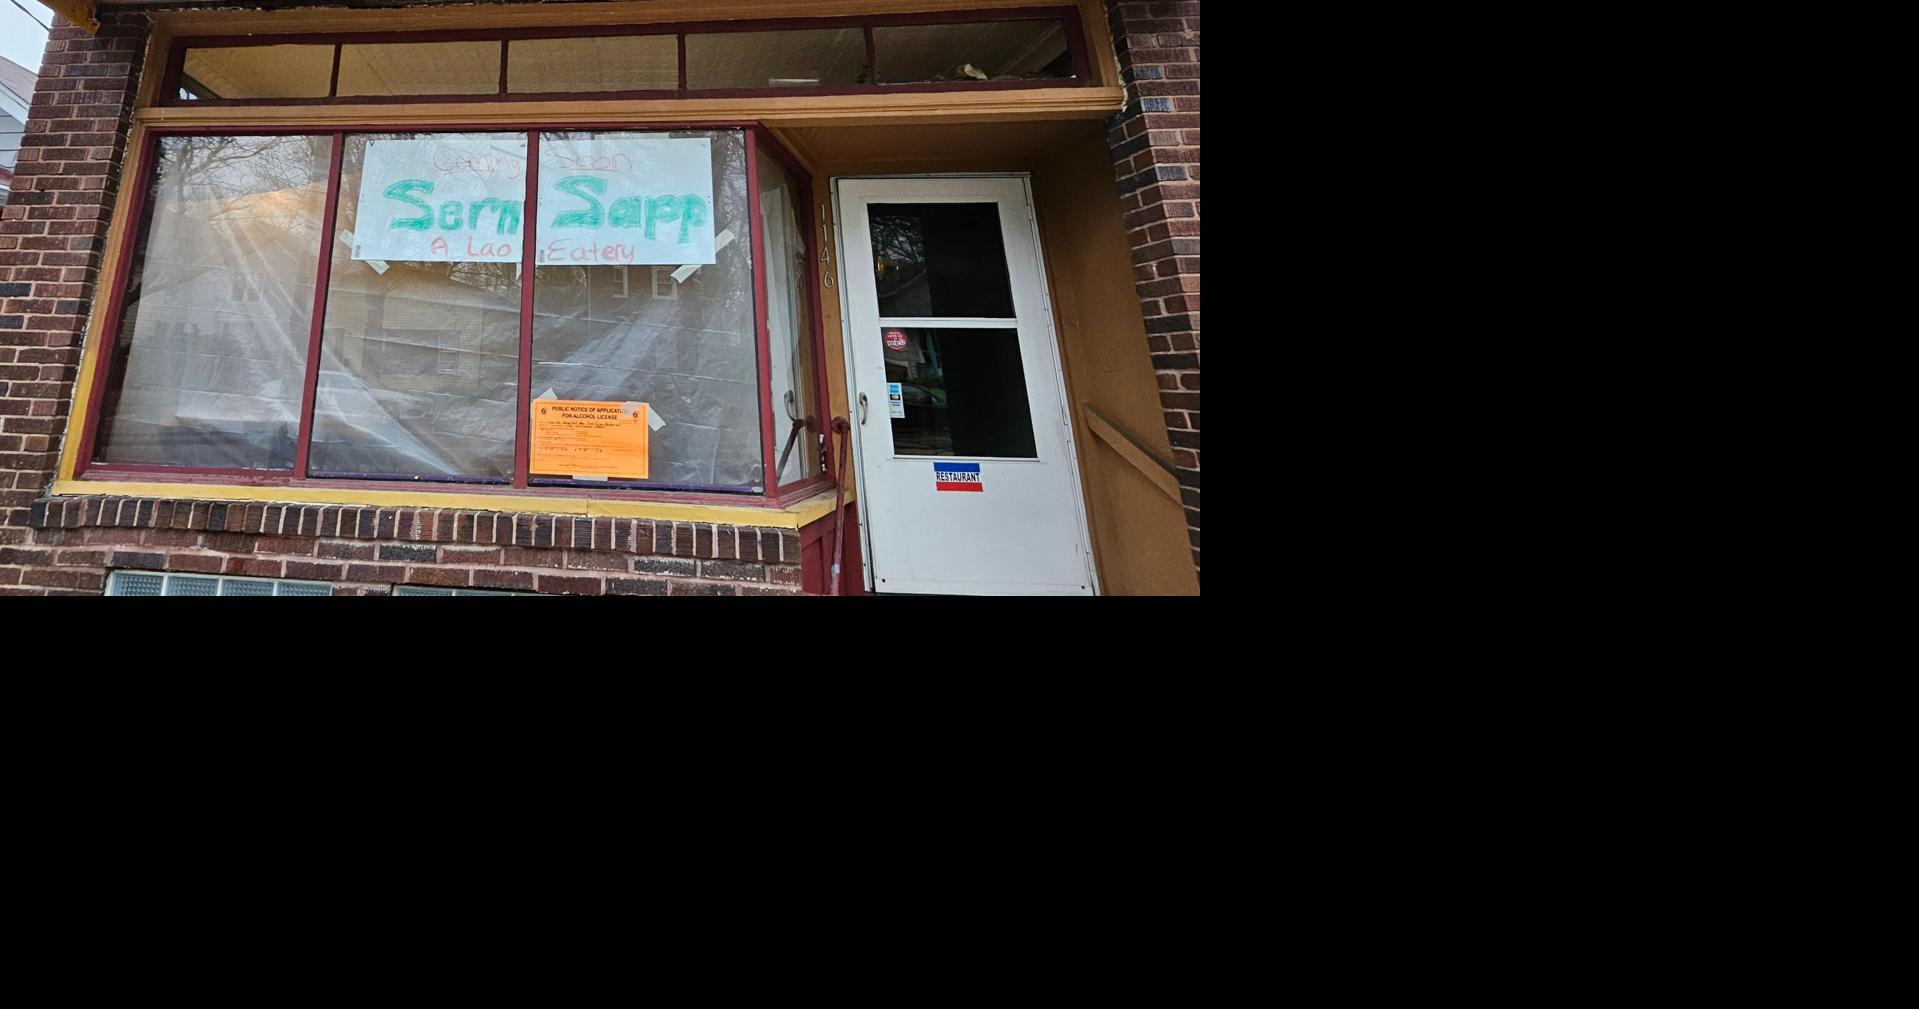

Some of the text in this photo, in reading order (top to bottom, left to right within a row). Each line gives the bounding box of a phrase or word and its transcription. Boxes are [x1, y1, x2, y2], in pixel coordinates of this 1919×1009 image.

[552, 175, 707, 245] Sapp
[430, 237, 449, 257] A
[466, 237, 512, 257] Lao
[547, 239, 636, 262] Eatery
[820, 203, 834, 289] 1146
[936, 472, 980, 481] RESTAURANT
